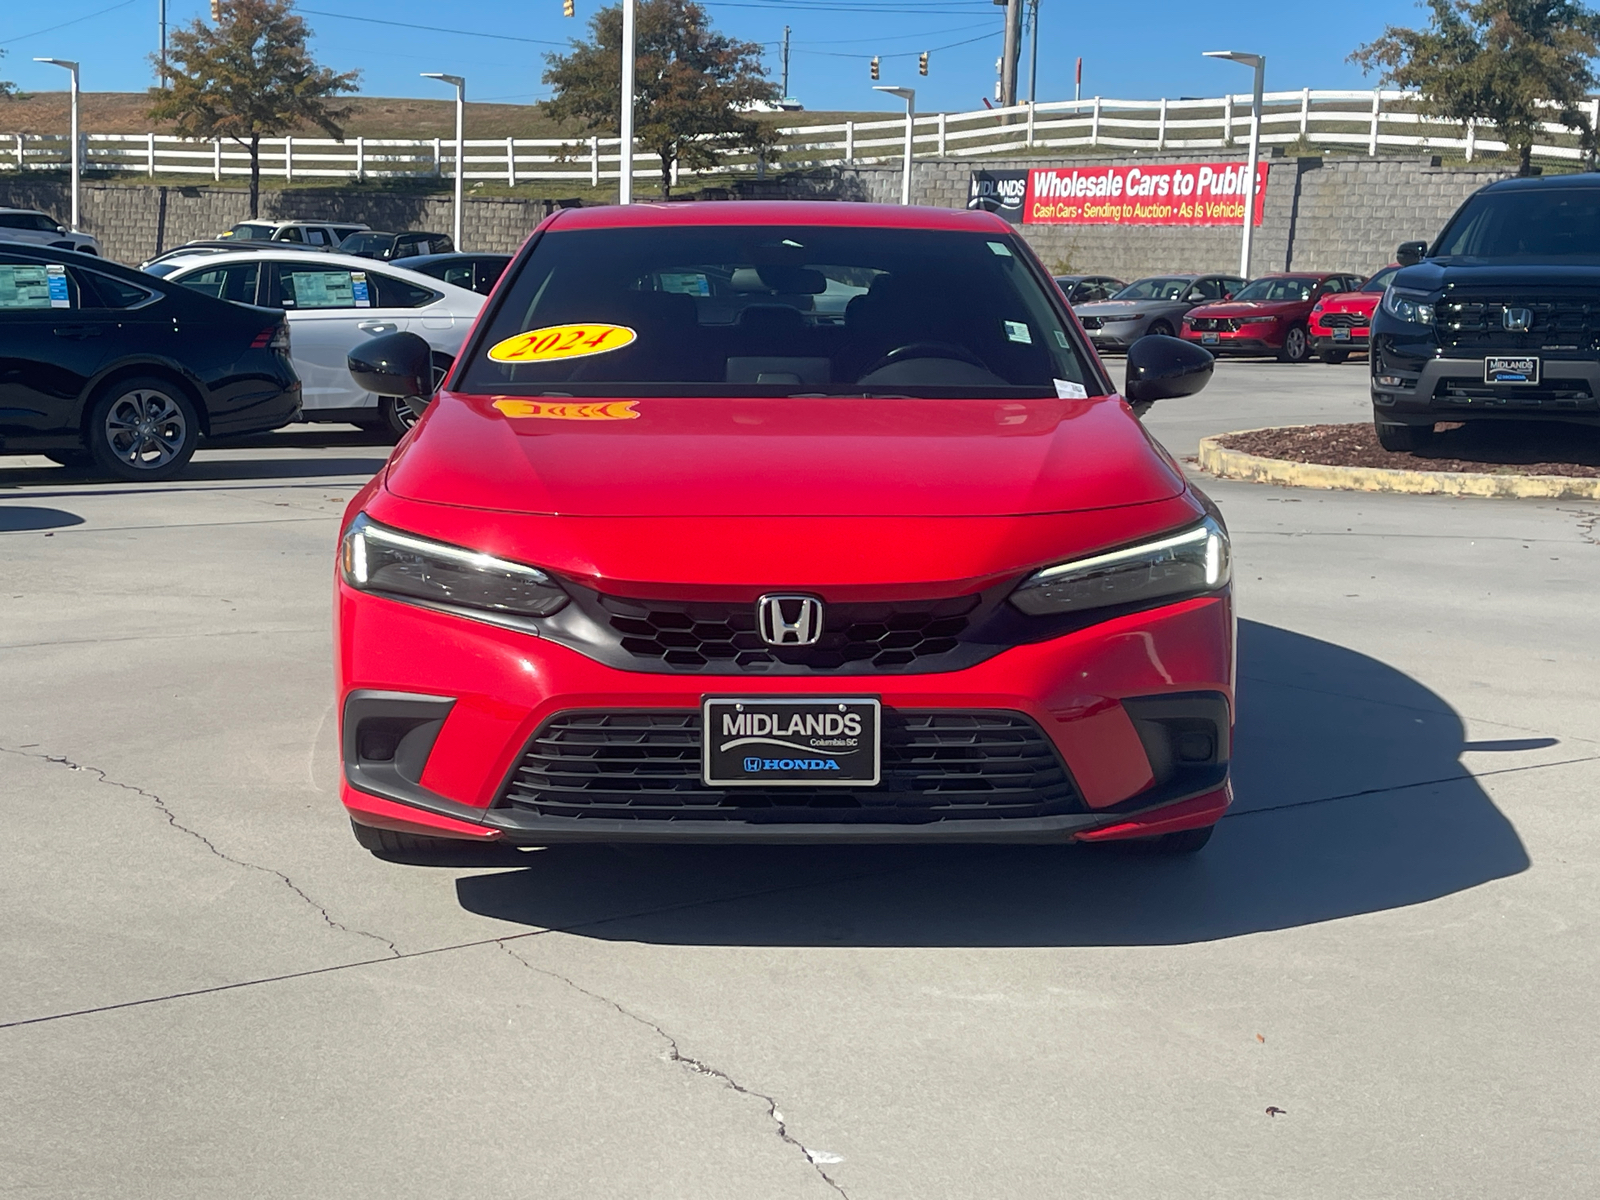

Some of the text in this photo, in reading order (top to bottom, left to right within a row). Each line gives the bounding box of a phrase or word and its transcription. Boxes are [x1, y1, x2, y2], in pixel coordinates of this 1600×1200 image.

[971, 180, 1026, 196] MIDLANDS
[1034, 169, 1123, 197] Wholesale
[1126, 168, 1171, 197] Cars
[1173, 169, 1194, 196] to
[1033, 201, 1245, 221] Cash Cars Sending to Auction As Is Vehicle
[506, 328, 615, 358] 2024
[1490, 361, 1533, 369] MIDLANDS
[723, 713, 862, 736] MIDLANDS
[810, 738, 858, 746] Columbia SC
[763, 759, 840, 770] HONDA
